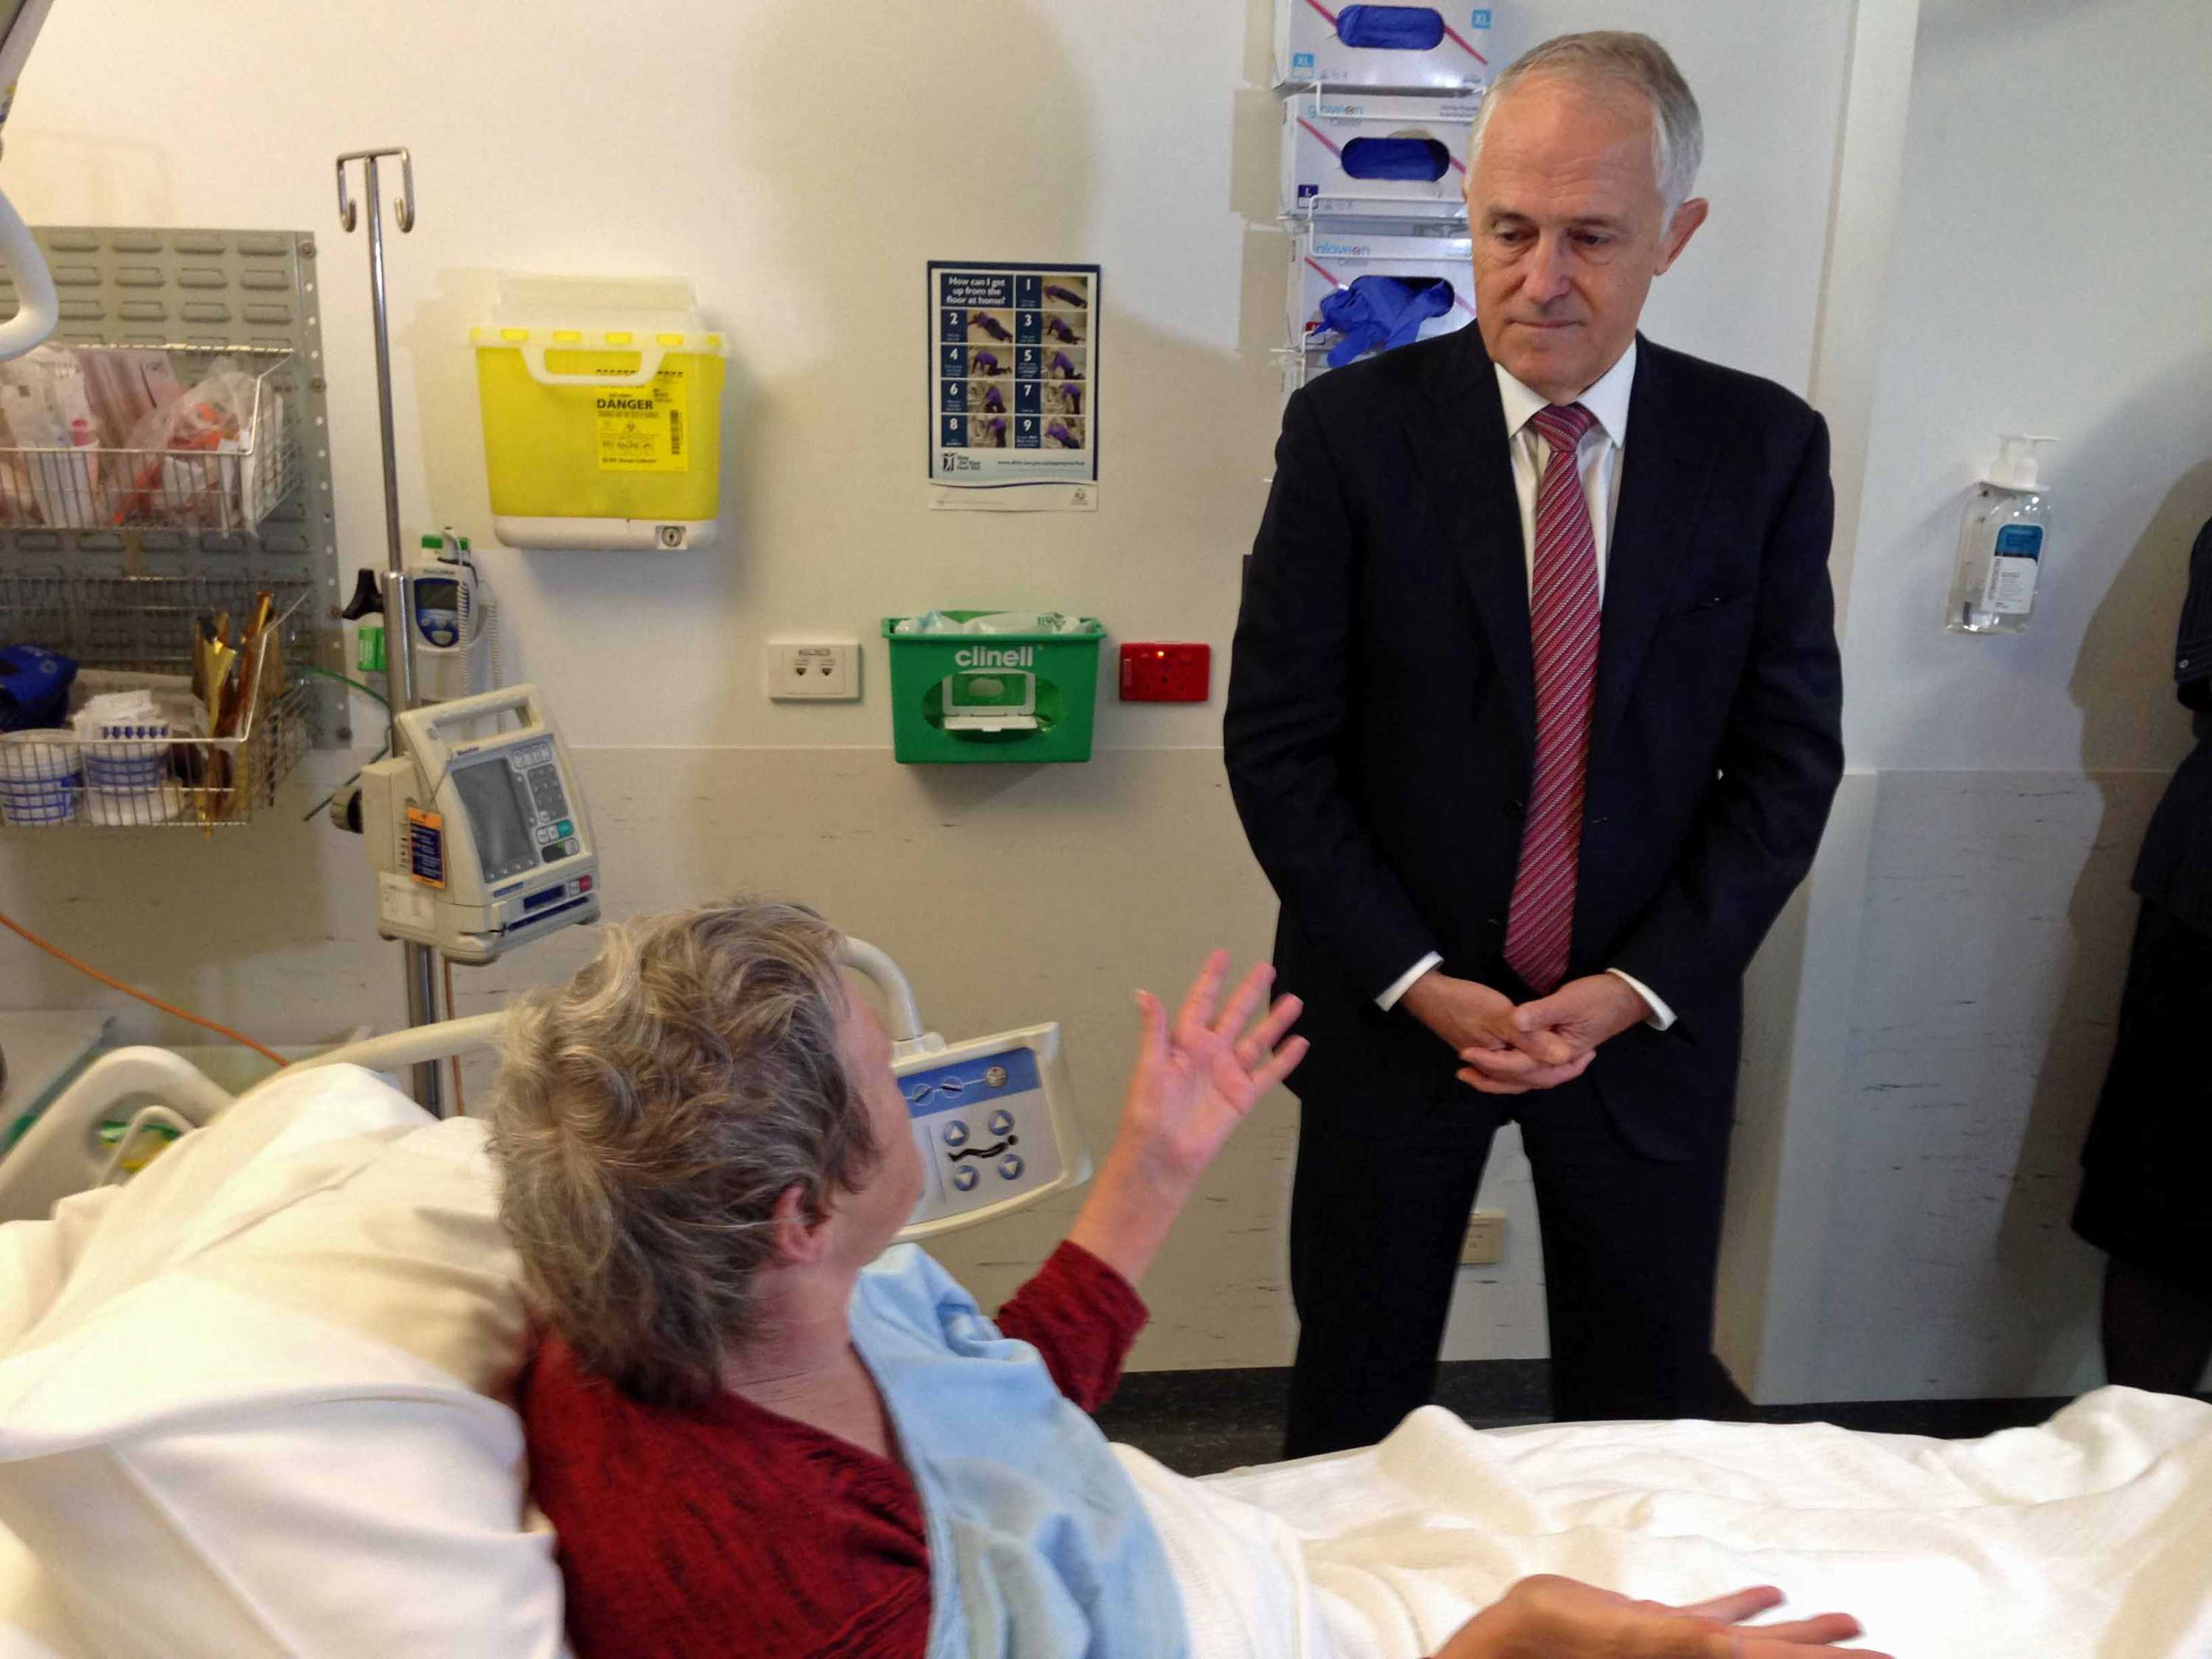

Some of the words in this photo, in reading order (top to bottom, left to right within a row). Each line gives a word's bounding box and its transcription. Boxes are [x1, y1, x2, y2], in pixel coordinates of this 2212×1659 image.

[949, 276, 969, 285] How
[992, 278, 1005, 288] get
[1026, 278, 1031, 291] 1
[953, 288, 964, 296] up
[965, 286, 986, 294] from
[950, 313, 958, 325] 2
[1024, 314, 1032, 327] 3
[950, 348, 958, 360] 4
[1024, 349, 1032, 361] 5
[950, 383, 958, 395] 6
[1024, 385, 1032, 397] 7
[596, 399, 653, 410] DANGER
[950, 418, 958, 430] 8
[1024, 420, 1032, 431] 9
[955, 646, 1034, 667] clinell
